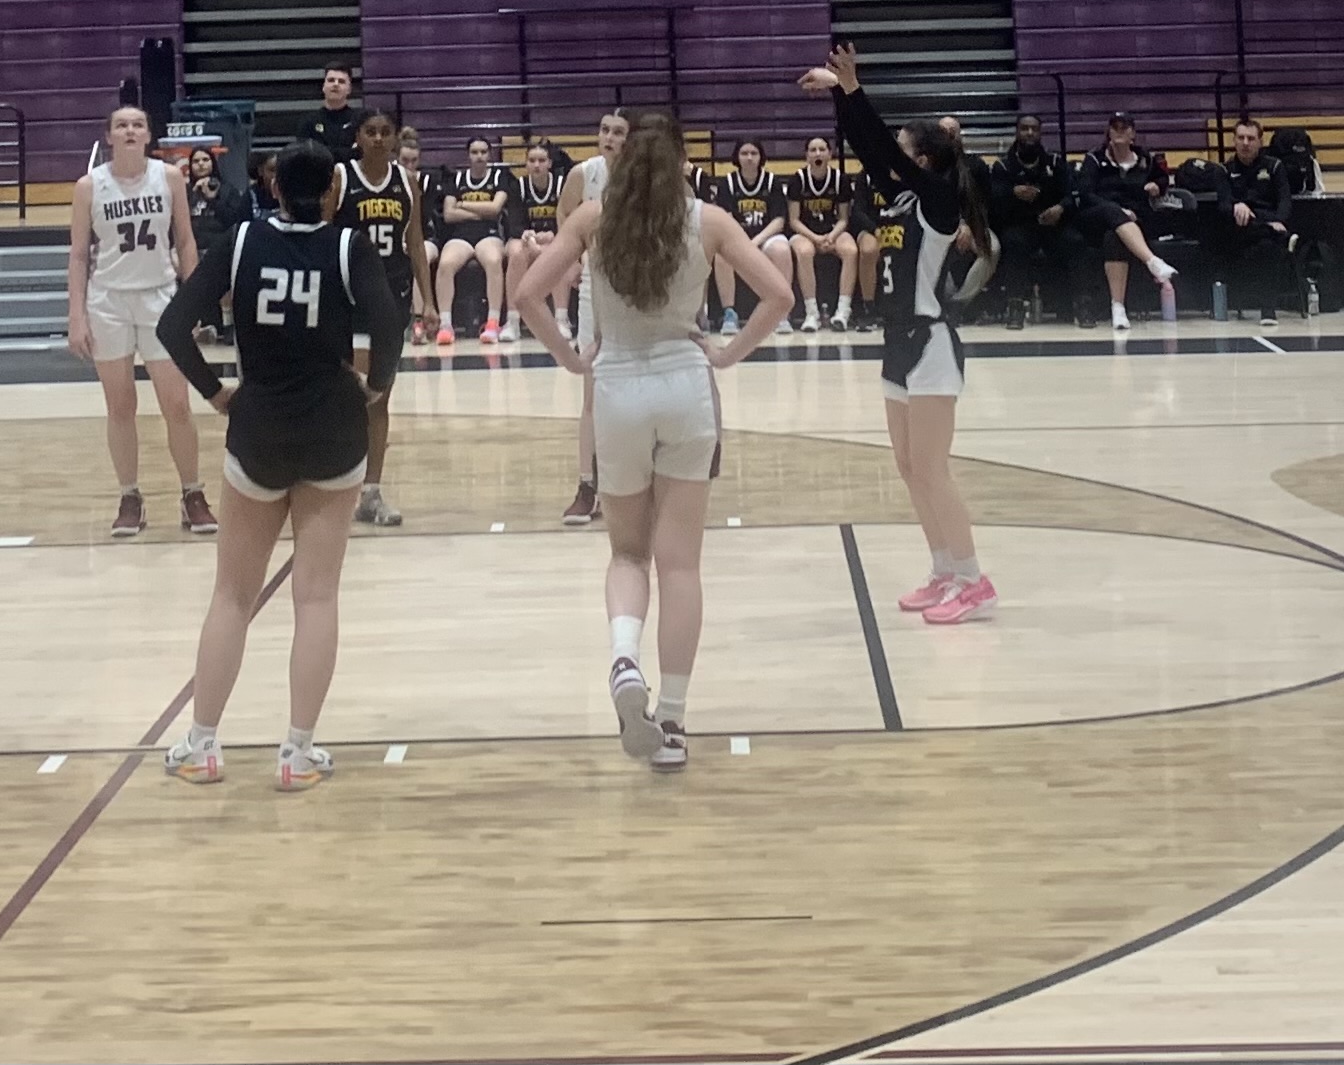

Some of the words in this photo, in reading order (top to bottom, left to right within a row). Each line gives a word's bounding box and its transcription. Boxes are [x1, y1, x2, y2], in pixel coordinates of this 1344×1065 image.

[103, 195, 164, 221] HUSKIES
[357, 198, 403, 223] TIGERS
[116, 218, 157, 254] 34
[368, 223, 394, 257] 15
[256, 266, 321, 328] 24
